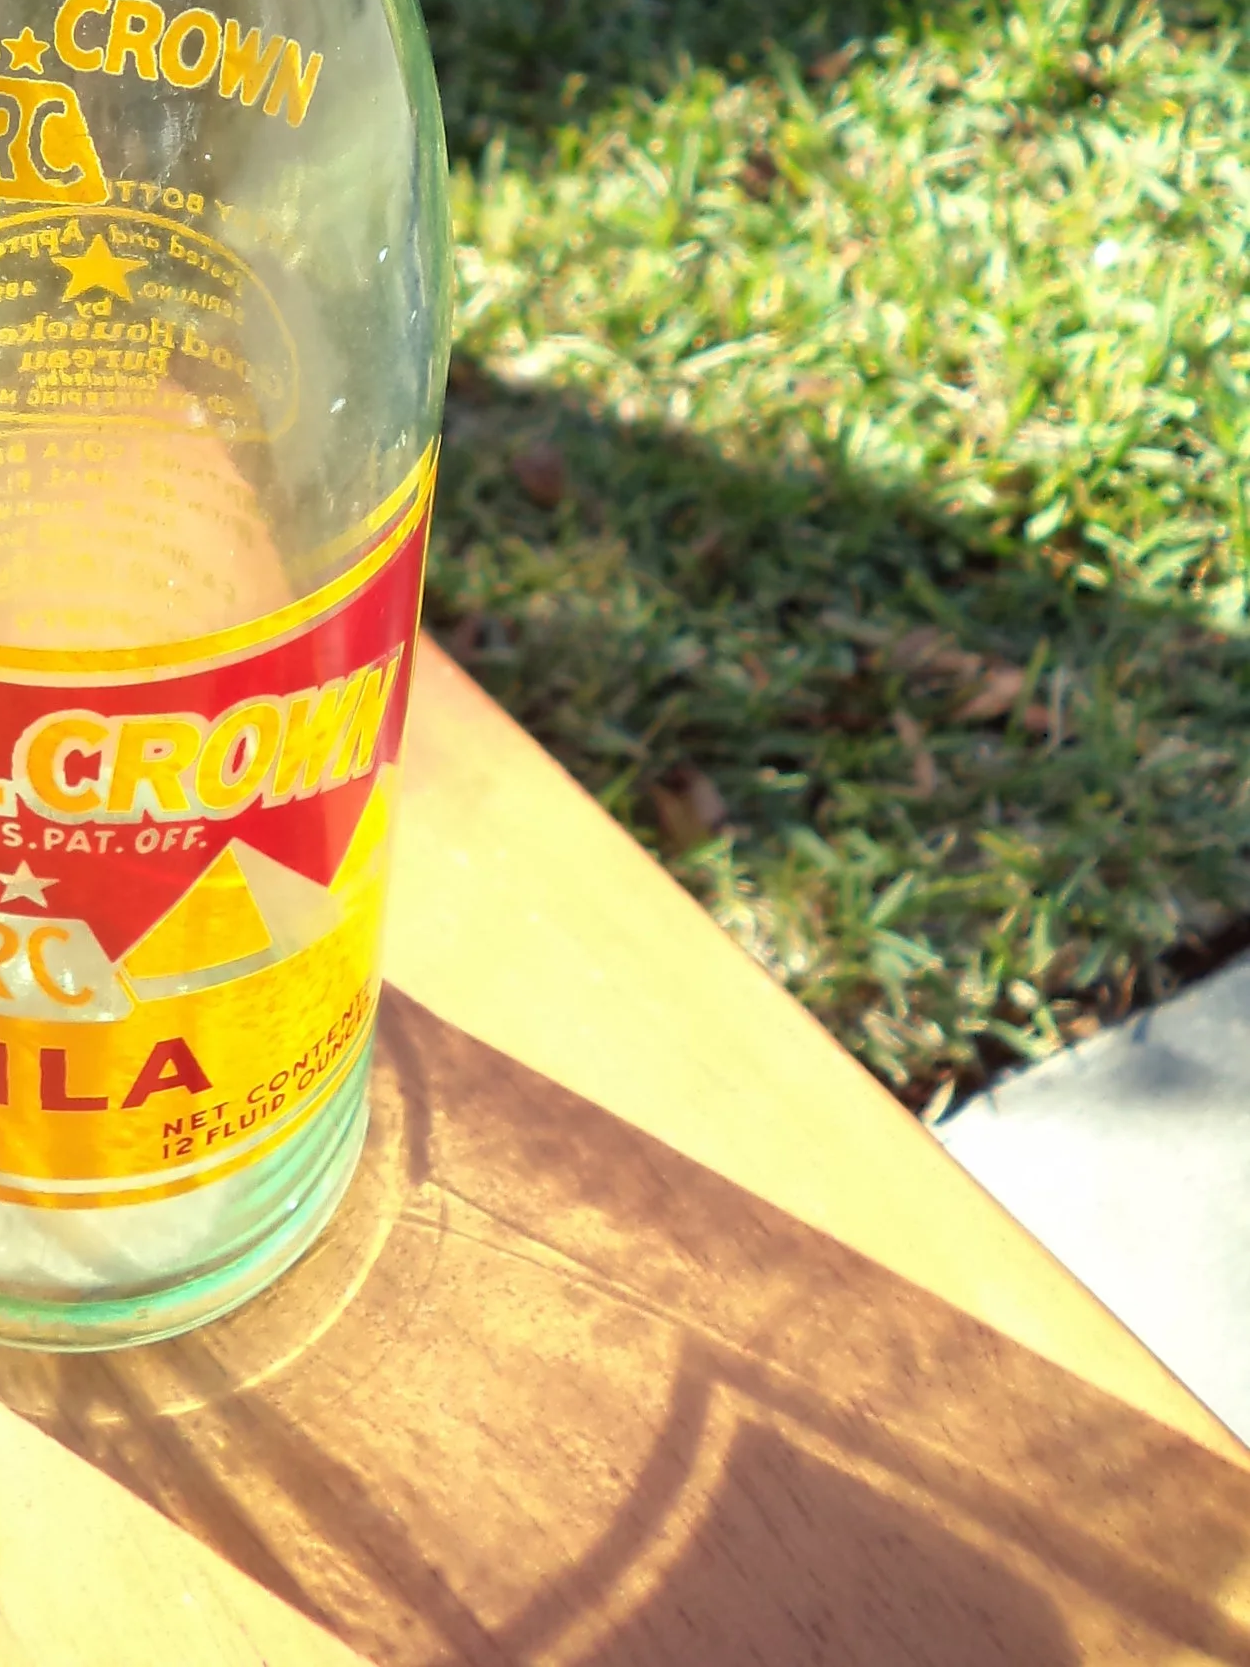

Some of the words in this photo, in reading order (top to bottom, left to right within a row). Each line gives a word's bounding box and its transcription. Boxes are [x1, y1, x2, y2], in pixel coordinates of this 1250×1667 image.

[13, 644, 406, 827] CROWN
[134, 825, 208, 855] OFF.
[162, 1100, 230, 1139] NET
[162, 1136, 195, 1161] 12
[205, 1093, 287, 1146] FLUID
